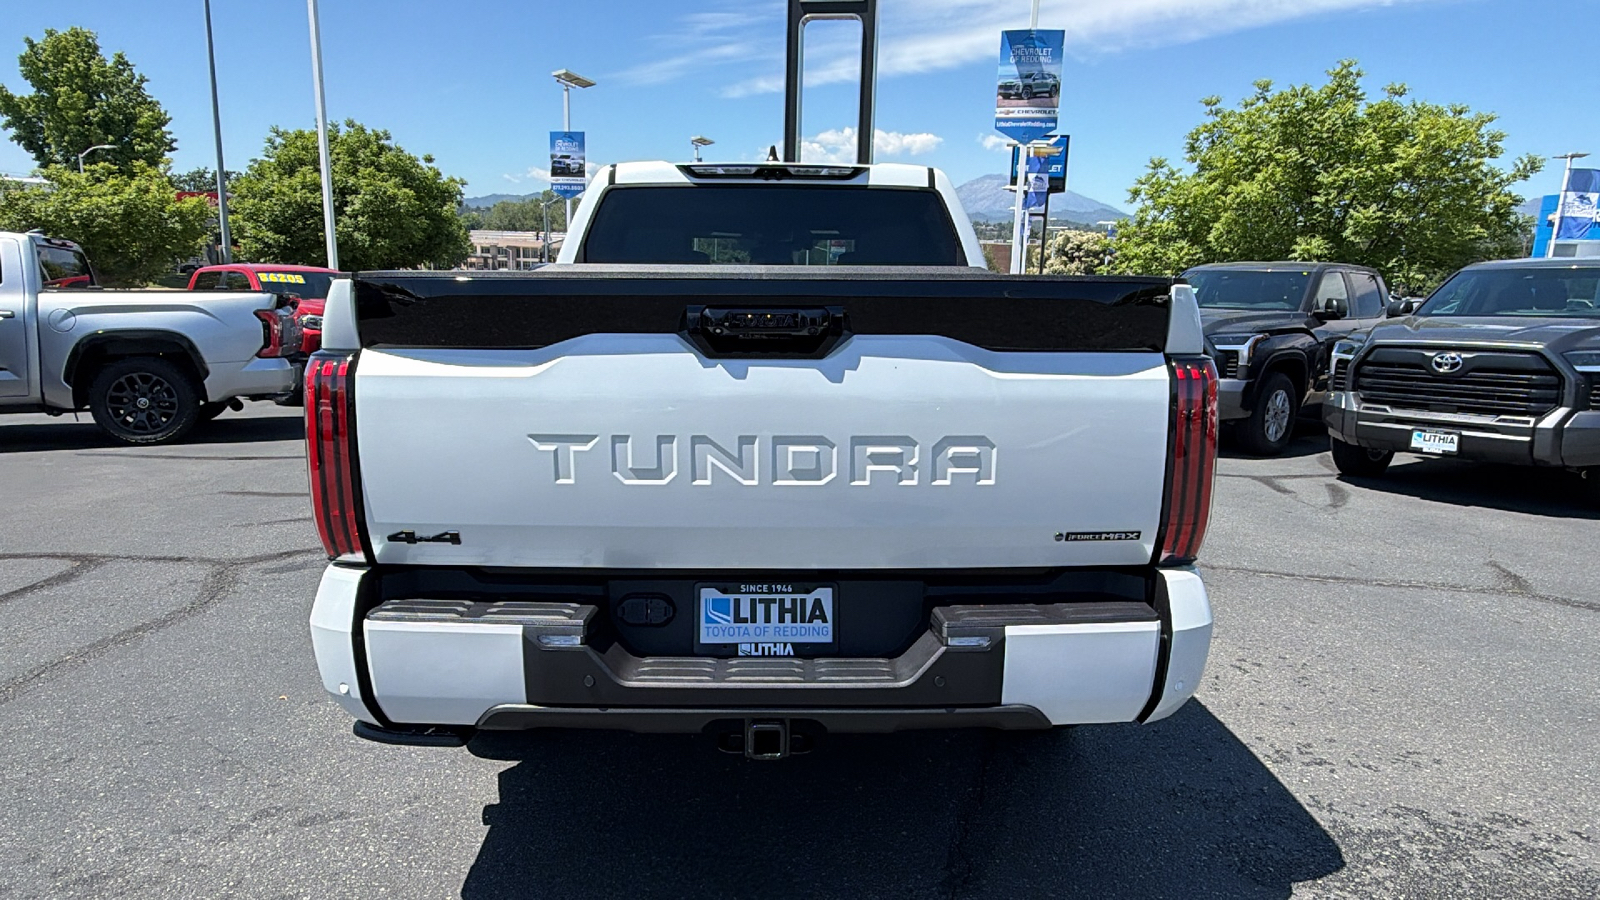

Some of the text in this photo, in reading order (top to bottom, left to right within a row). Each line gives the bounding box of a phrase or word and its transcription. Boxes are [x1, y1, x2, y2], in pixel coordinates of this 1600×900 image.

[1010, 48, 1052, 56] CHEVROLET
[1423, 433, 1456, 444] LITHIA
[527, 434, 997, 486] TUNDRA
[733, 598, 829, 623] LITHIA
[705, 626, 829, 637] TOYOTA OF REDDING
[749, 643, 794, 655] LITHIA
